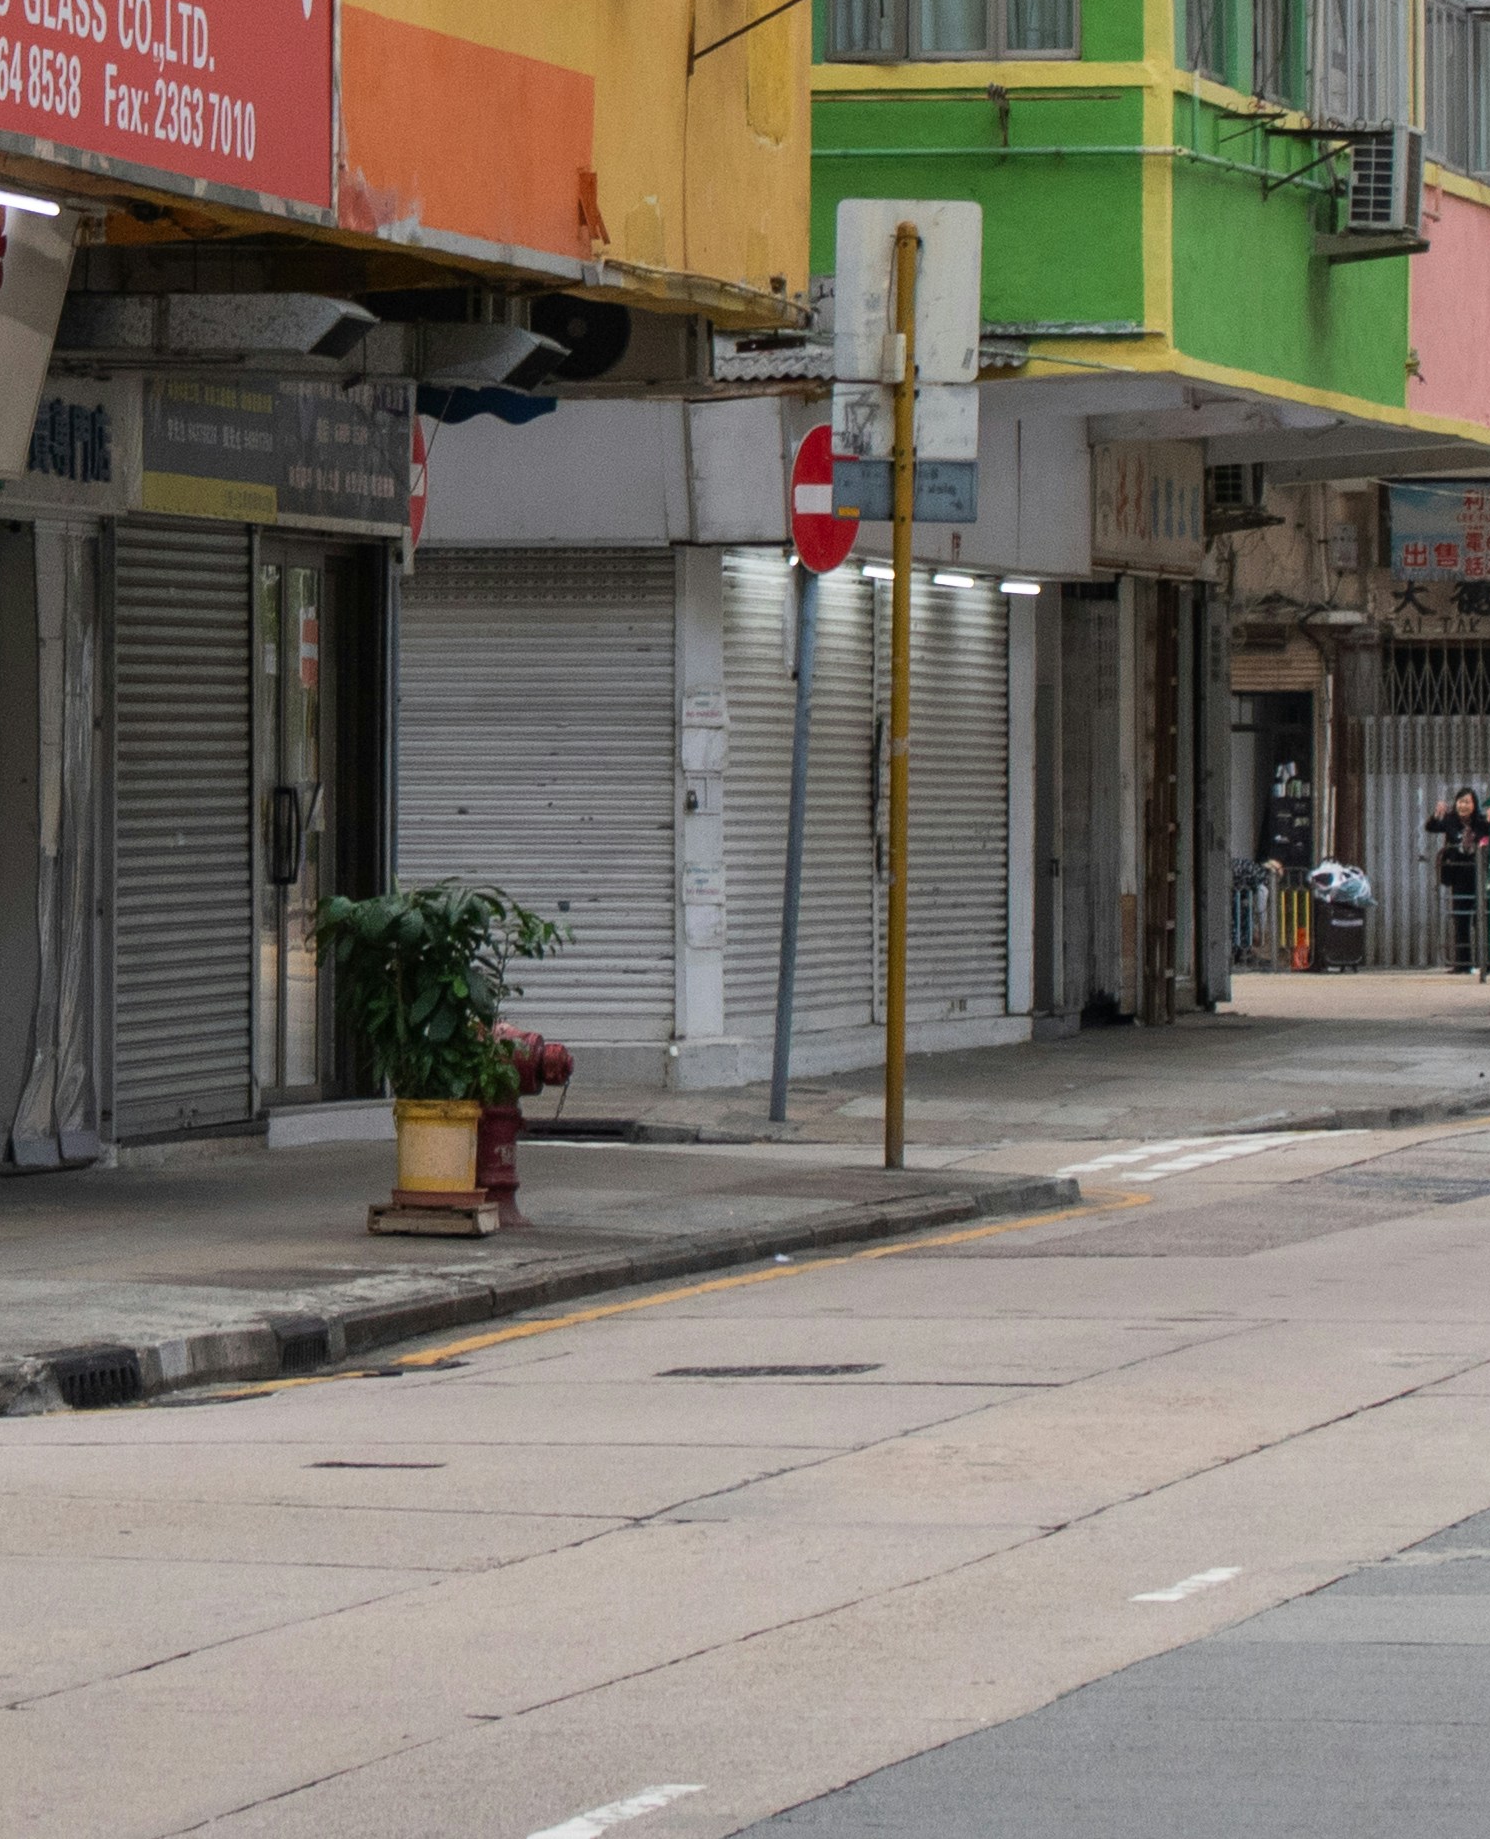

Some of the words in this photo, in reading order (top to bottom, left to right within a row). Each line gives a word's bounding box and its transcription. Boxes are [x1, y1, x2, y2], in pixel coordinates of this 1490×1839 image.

[28, 42, 82, 119] 8538
[104, 62, 150, 136] Fax:
[154, 75, 204, 150] 2363
[209, 91, 257, 162] 7010
[1403, 542, 1459, 568] 出售
